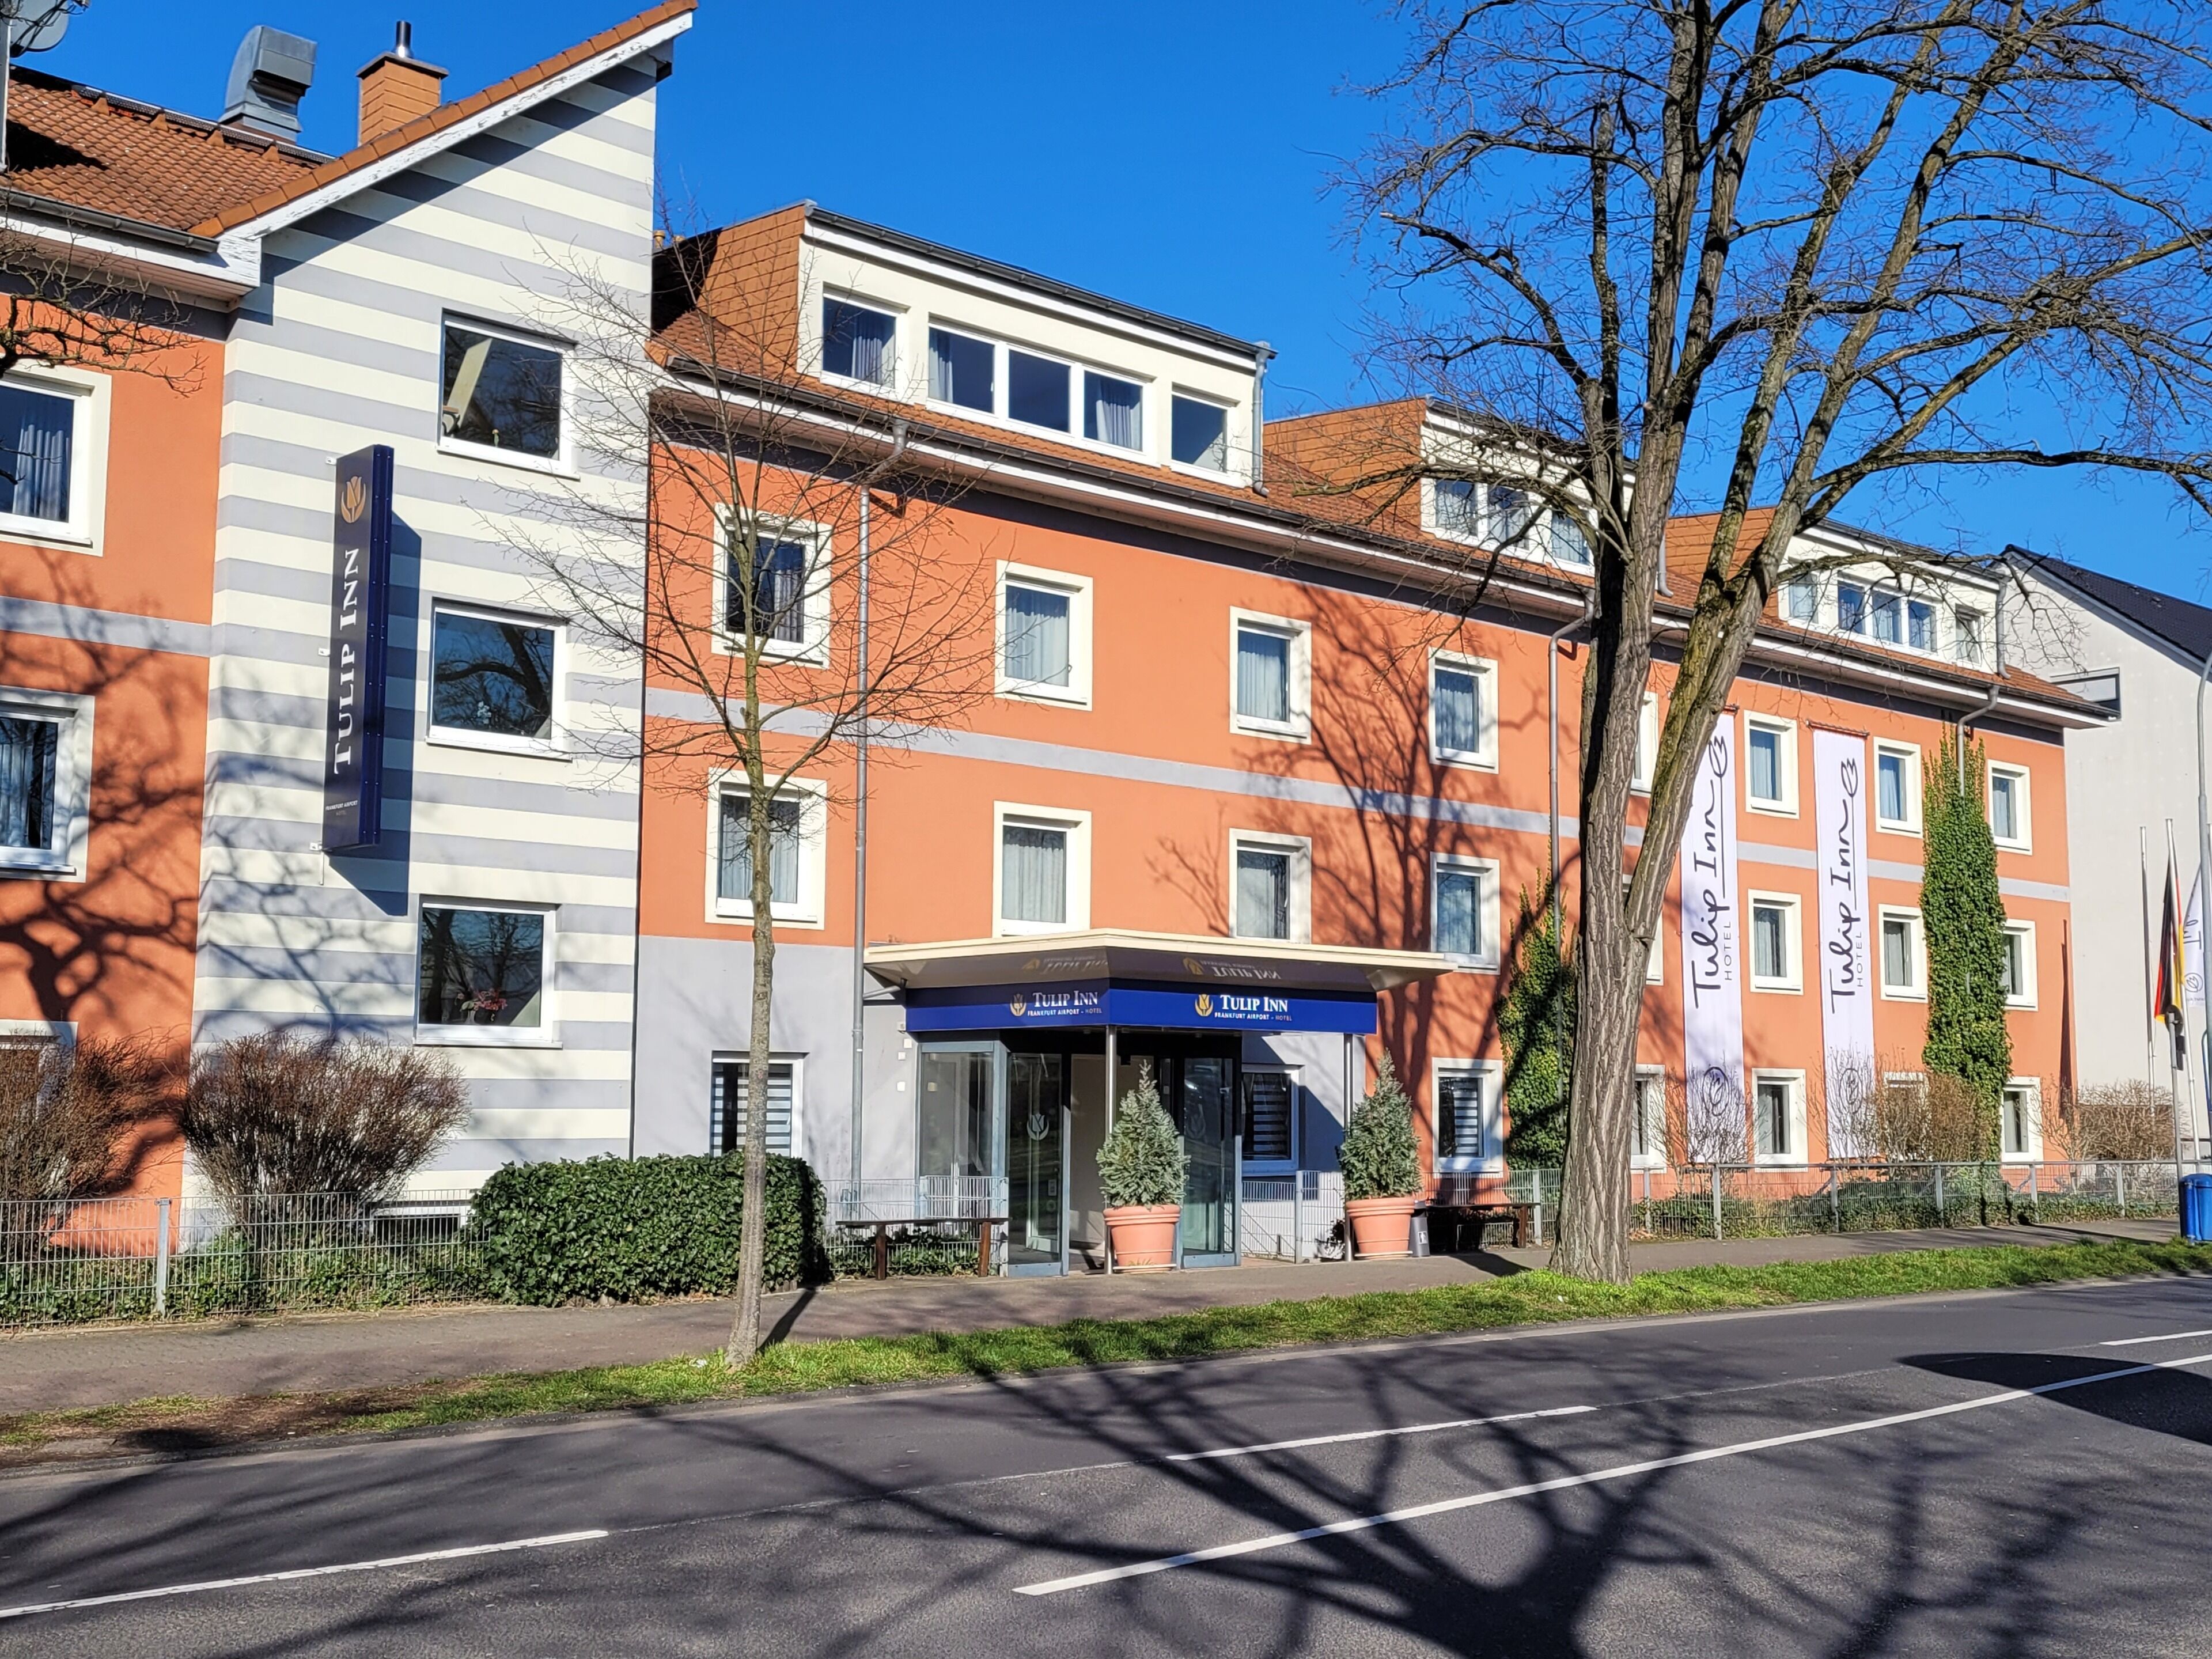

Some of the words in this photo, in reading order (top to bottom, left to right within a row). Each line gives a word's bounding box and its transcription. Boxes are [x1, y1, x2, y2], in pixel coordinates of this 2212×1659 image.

[339, 548, 359, 630] INN
[334, 643, 355, 774] TULIP
[1694, 779, 1717, 878] Inn
[1830, 799, 1851, 891] Inn
[1691, 889, 1730, 1009] Tulip
[1724, 921, 1732, 980] HOTEL
[1828, 902, 1861, 1014] Tulip
[1032, 991, 1070, 1007] TULIP
[1073, 990, 1099, 1006] INN
[1219, 994, 1260, 1011] TULIP
[1263, 997, 1288, 1012] INN
